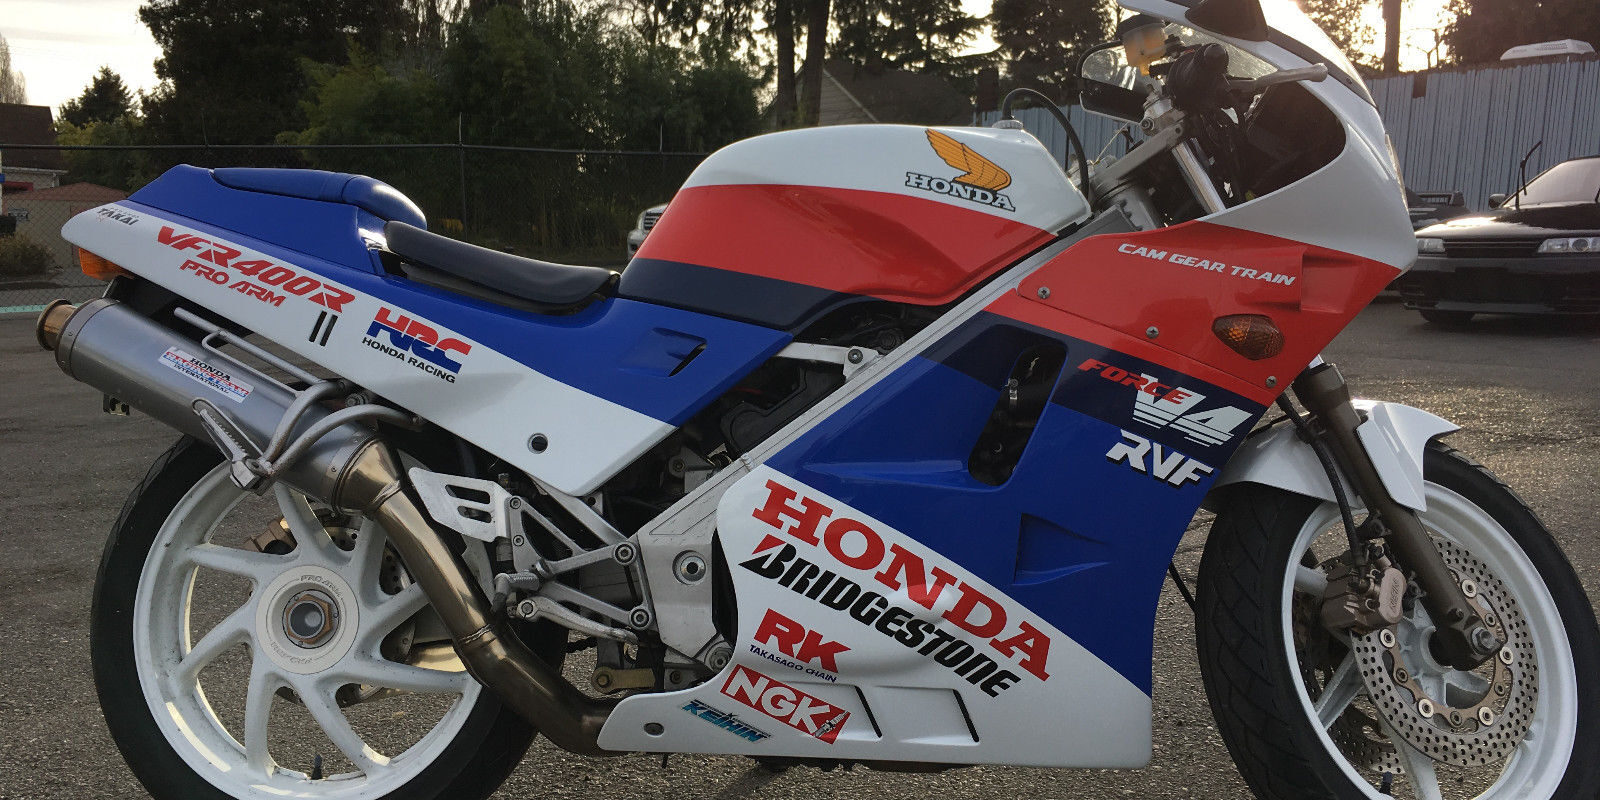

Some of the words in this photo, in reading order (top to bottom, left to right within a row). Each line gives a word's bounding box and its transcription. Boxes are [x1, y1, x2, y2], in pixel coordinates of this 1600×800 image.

[905, 171, 1015, 212] HONDA
[158, 226, 356, 313] VFR400R
[180, 259, 230, 285] PRO
[228, 280, 286, 307] ARM
[1117, 243, 1168, 260] CAM
[1168, 253, 1226, 273] GEAR
[1230, 265, 1296, 286] TRAIN
[362, 337, 405, 361] HONDA
[407, 356, 456, 384] RACING
[366, 306, 472, 374] HRC
[174, 363, 229, 394] INTERNATIONAL
[190, 357, 231, 381] HONDA
[1077, 358, 1193, 405] FORCE
[1132, 372, 1253, 448] V4
[1105, 428, 1214, 488] RVF
[752, 479, 1051, 682] HONDA
[738, 533, 1021, 698] BRIDGESTONE
[749, 644, 803, 671] TAKASAGO
[805, 667, 837, 683] CHAIN
[753, 608, 852, 673] RK
[682, 700, 770, 742] KEIHIN
[725, 667, 831, 735] NGK
